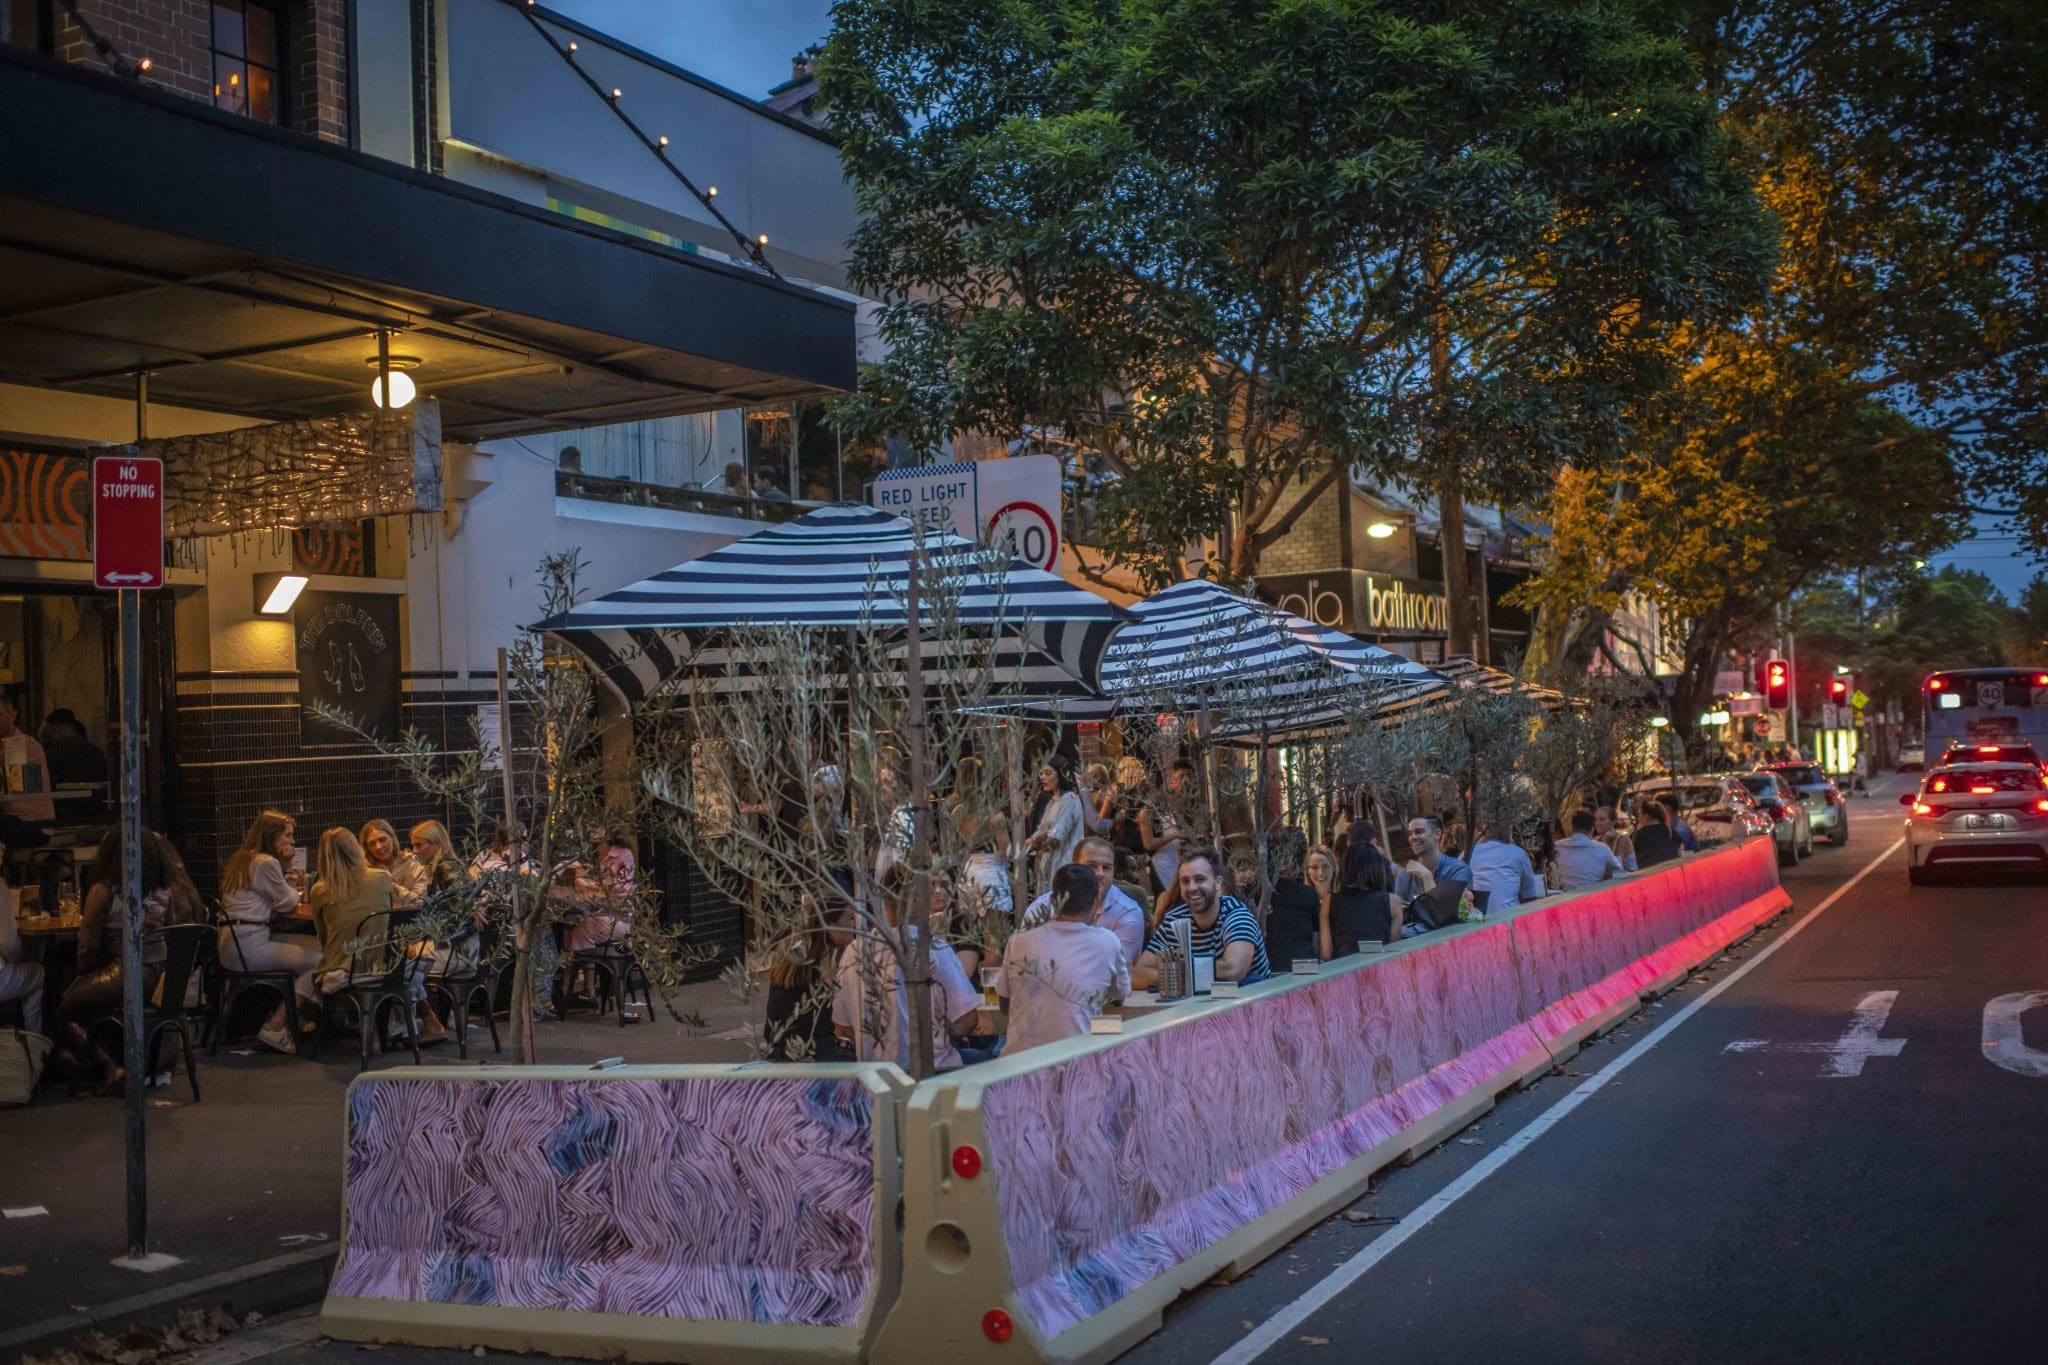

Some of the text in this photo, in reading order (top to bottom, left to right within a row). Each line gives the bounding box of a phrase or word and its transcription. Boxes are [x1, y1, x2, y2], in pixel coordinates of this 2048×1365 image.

[119, 466, 138, 480] NO
[102, 483, 155, 498] STOPPING
[881, 482, 967, 506] RED LIGHT
[324, 603, 387, 653] DOLPHIN
[1981, 687, 2000, 701] 40
